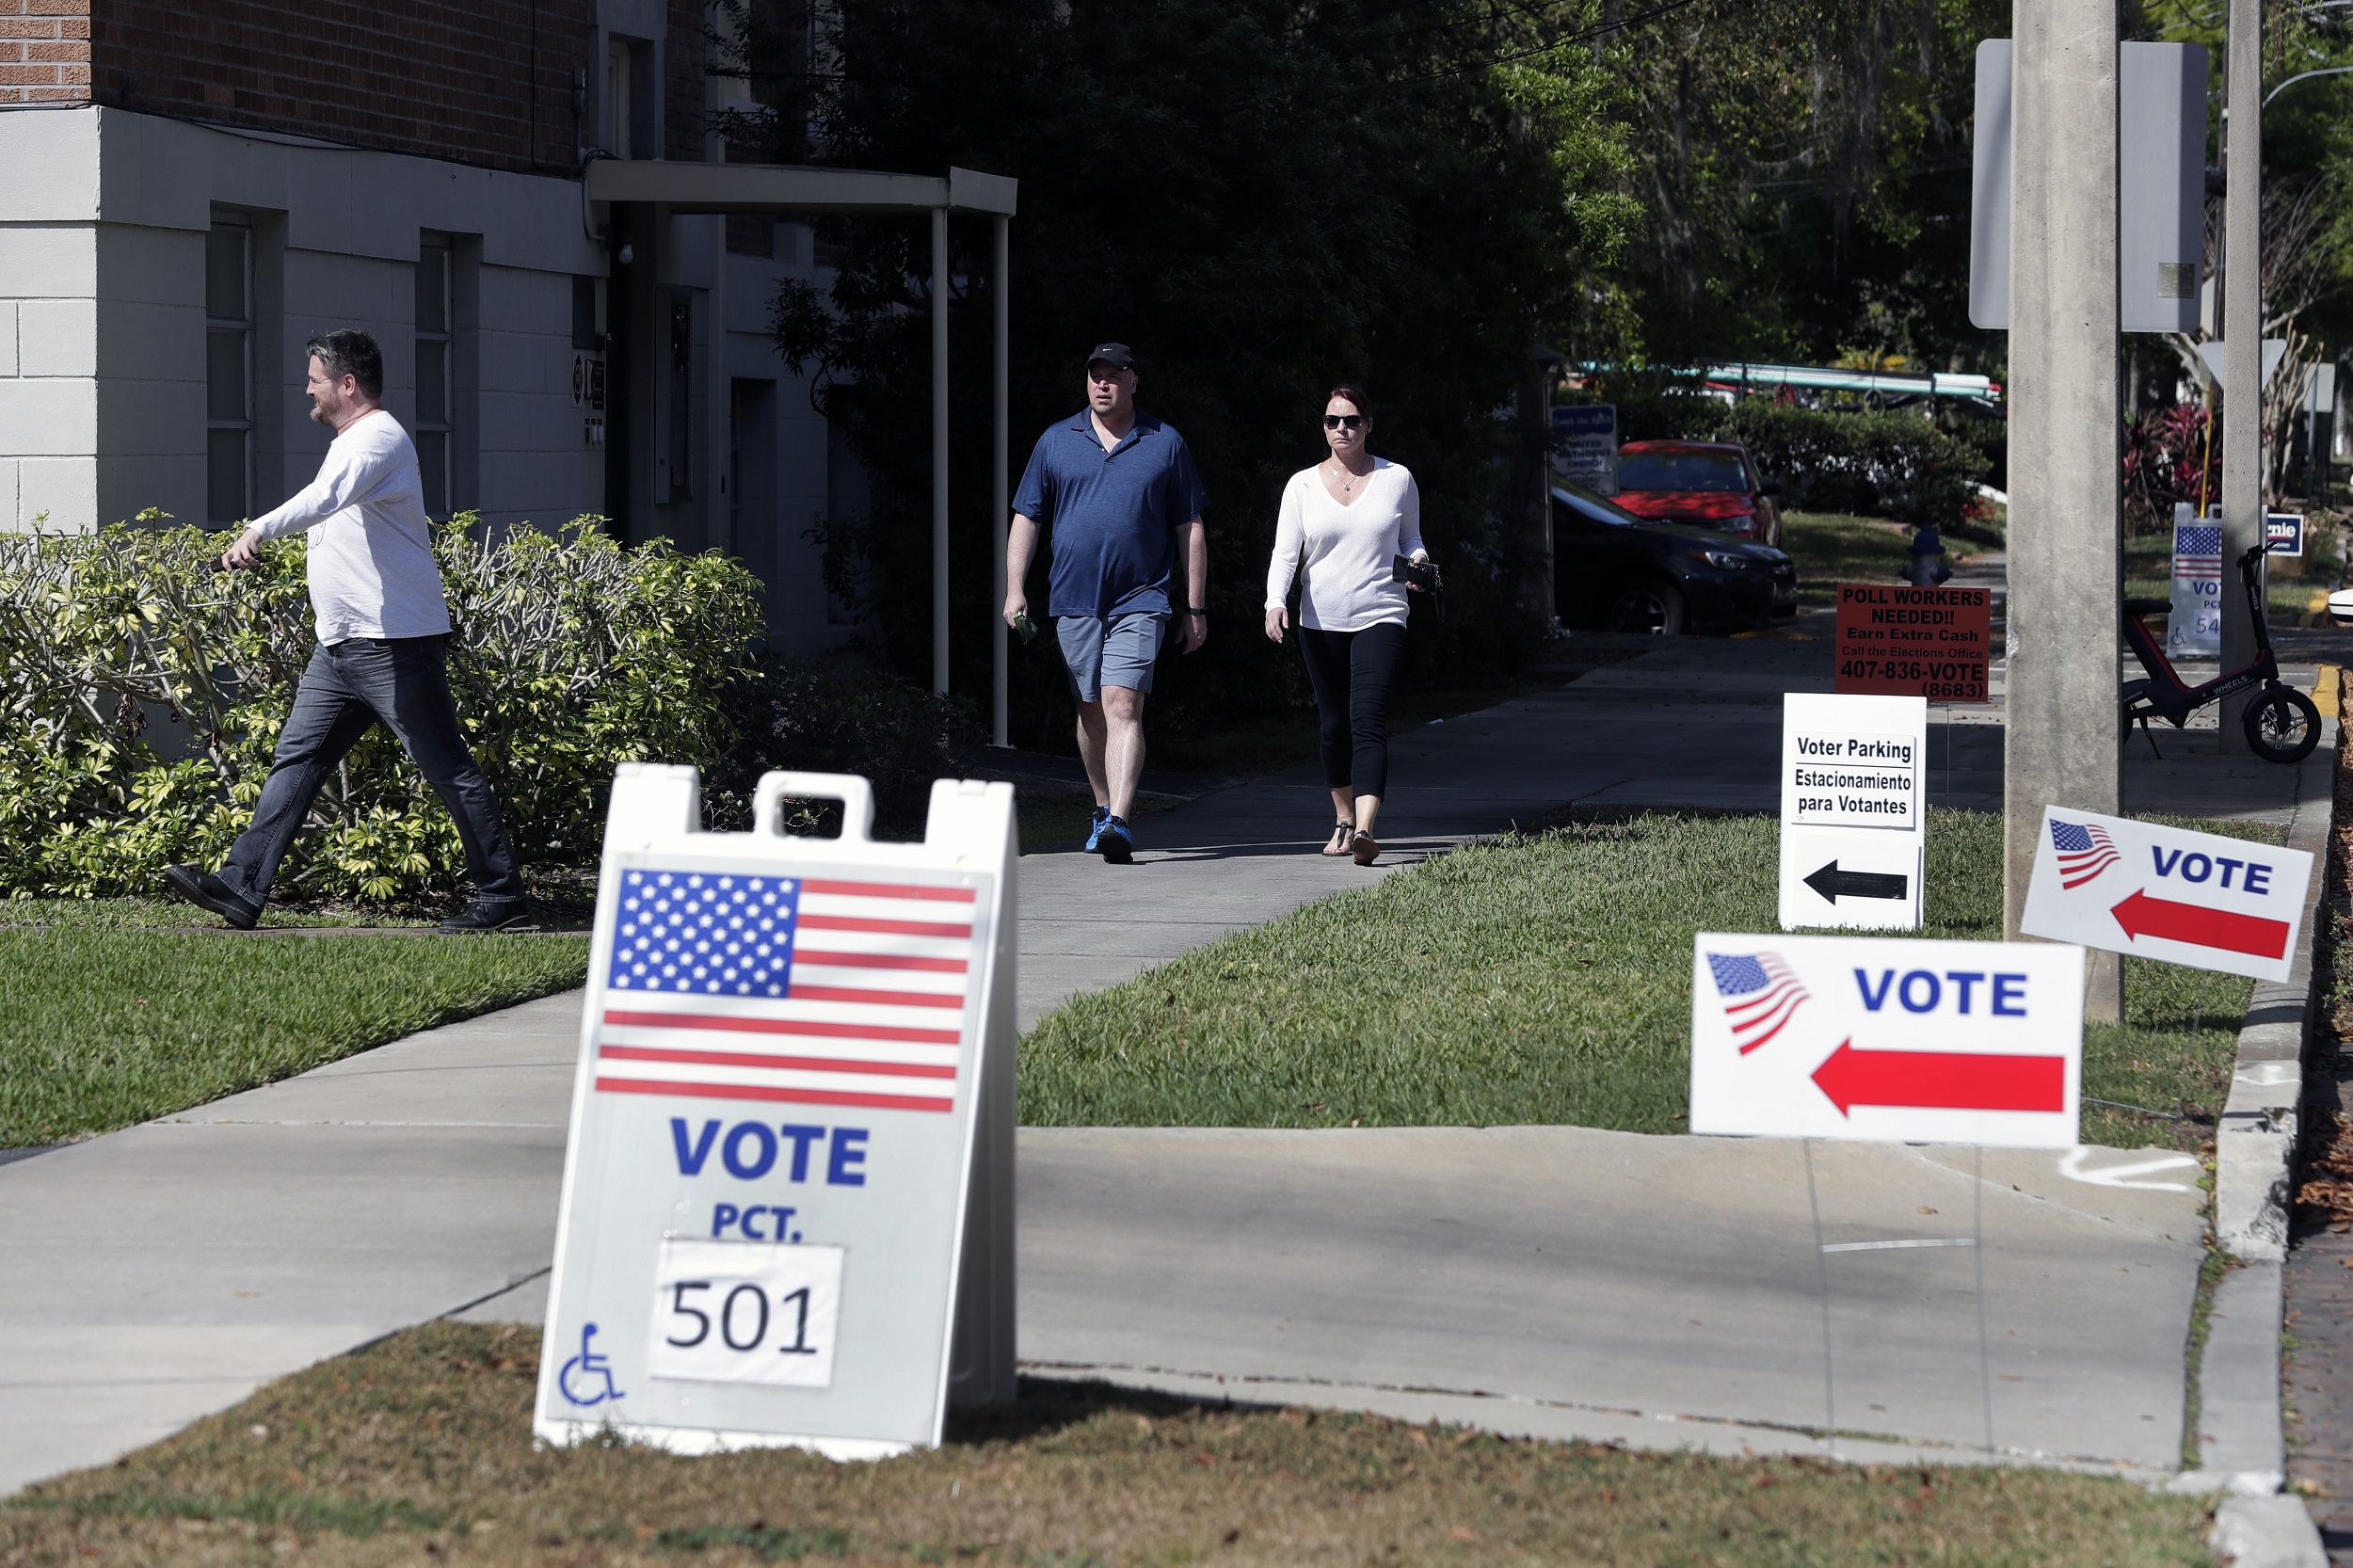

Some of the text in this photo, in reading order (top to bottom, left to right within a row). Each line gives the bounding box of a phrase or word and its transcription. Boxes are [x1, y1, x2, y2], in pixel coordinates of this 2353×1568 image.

[1843, 588, 1984, 606] POLL WORKERS
[2193, 581, 2221, 596] VO
[1871, 609, 1955, 625] NEEDED!!
[1847, 627, 1978, 642] Earn Extra Cash
[1842, 646, 1983, 659] Call the Elections Office
[1841, 660, 1983, 681] 407-836-VOTE
[1922, 682, 1984, 698] (8683)
[2213, 675, 2248, 695] WHEELS
[1798, 737, 1912, 763] Voter Parking
[1795, 769, 1911, 791] Estacionamiento
[1799, 795, 1907, 814] para Votantes
[2151, 844, 2274, 896] VOTE
[1852, 968, 2030, 1017] VOTE
[669, 1116, 871, 1188] VOTE
[712, 1202, 803, 1242] PCT.
[664, 1280, 818, 1354] 501
